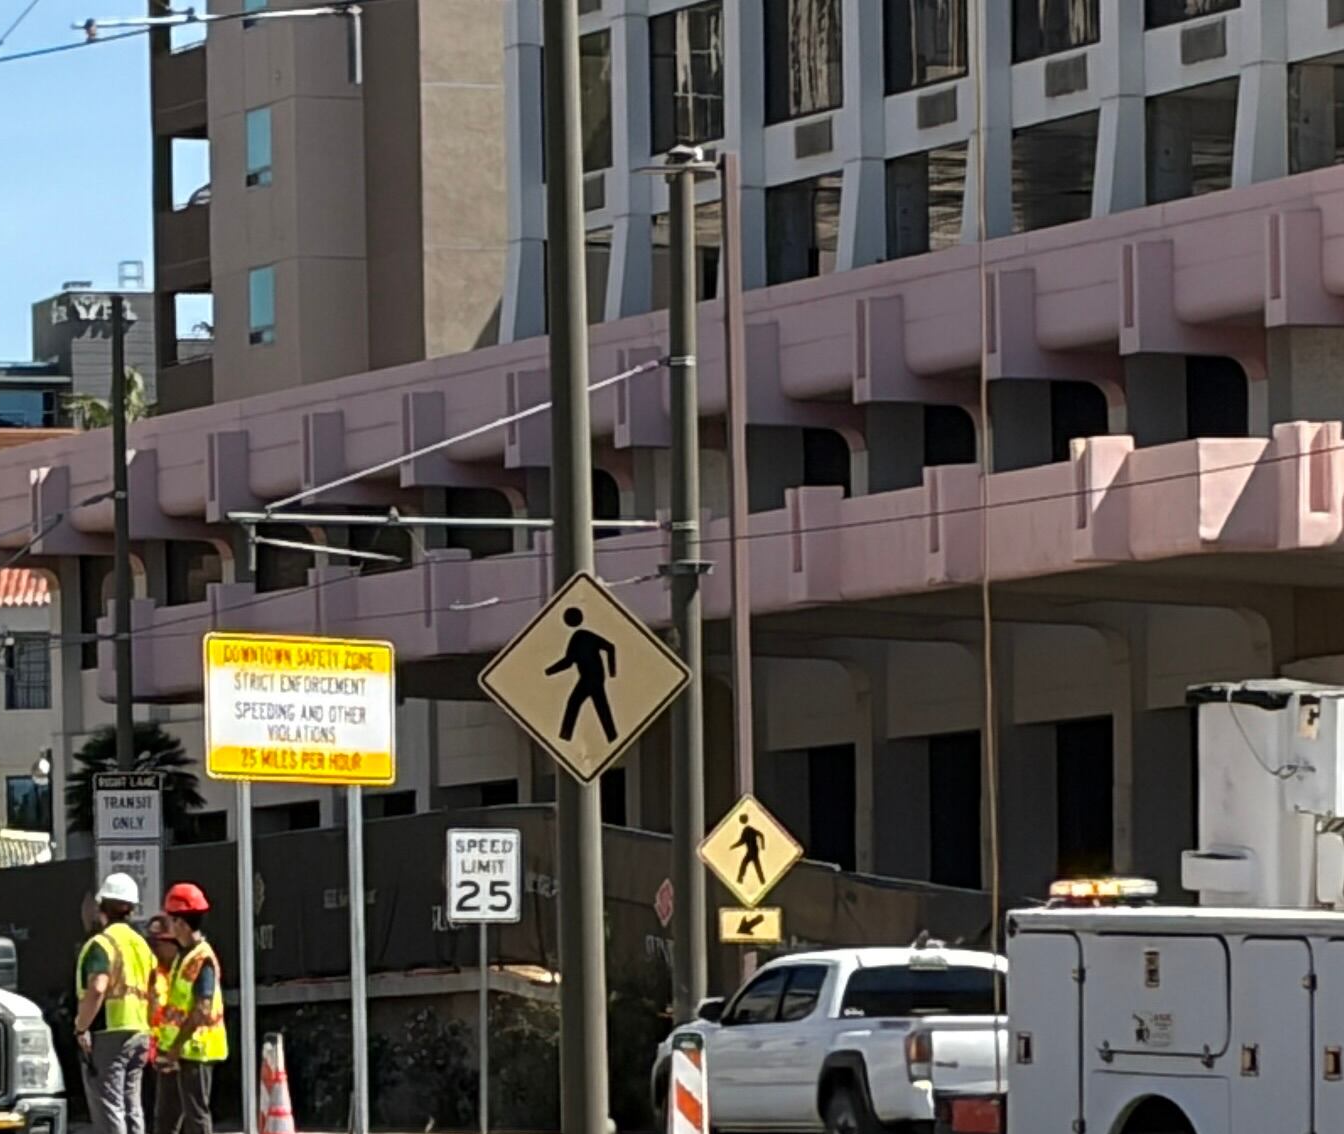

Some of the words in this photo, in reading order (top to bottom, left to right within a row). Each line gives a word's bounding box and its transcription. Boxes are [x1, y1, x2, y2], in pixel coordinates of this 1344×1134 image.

[223, 644, 293, 667] DOWNTOWN
[296, 647, 340, 670] SAFETY
[343, 650, 374, 671] ZONE
[234, 671, 275, 692] STRICT
[279, 674, 367, 696] ENFORCEMENT
[234, 701, 296, 721] SPEEDING
[300, 703, 324, 722] AND
[328, 705, 366, 724] OTHER
[267, 724, 336, 744] VIOLATIONS
[241, 748, 256, 768] 25
[260, 749, 297, 769] MILES
[301, 751, 325, 770] PER
[329, 752, 362, 771] HOUR
[103, 795, 152, 810] TRANSIT
[112, 816, 145, 831] ONLY
[455, 838, 514, 855] SPEED
[460, 859, 505, 875] LIMIT
[455, 880, 513, 912] 25
